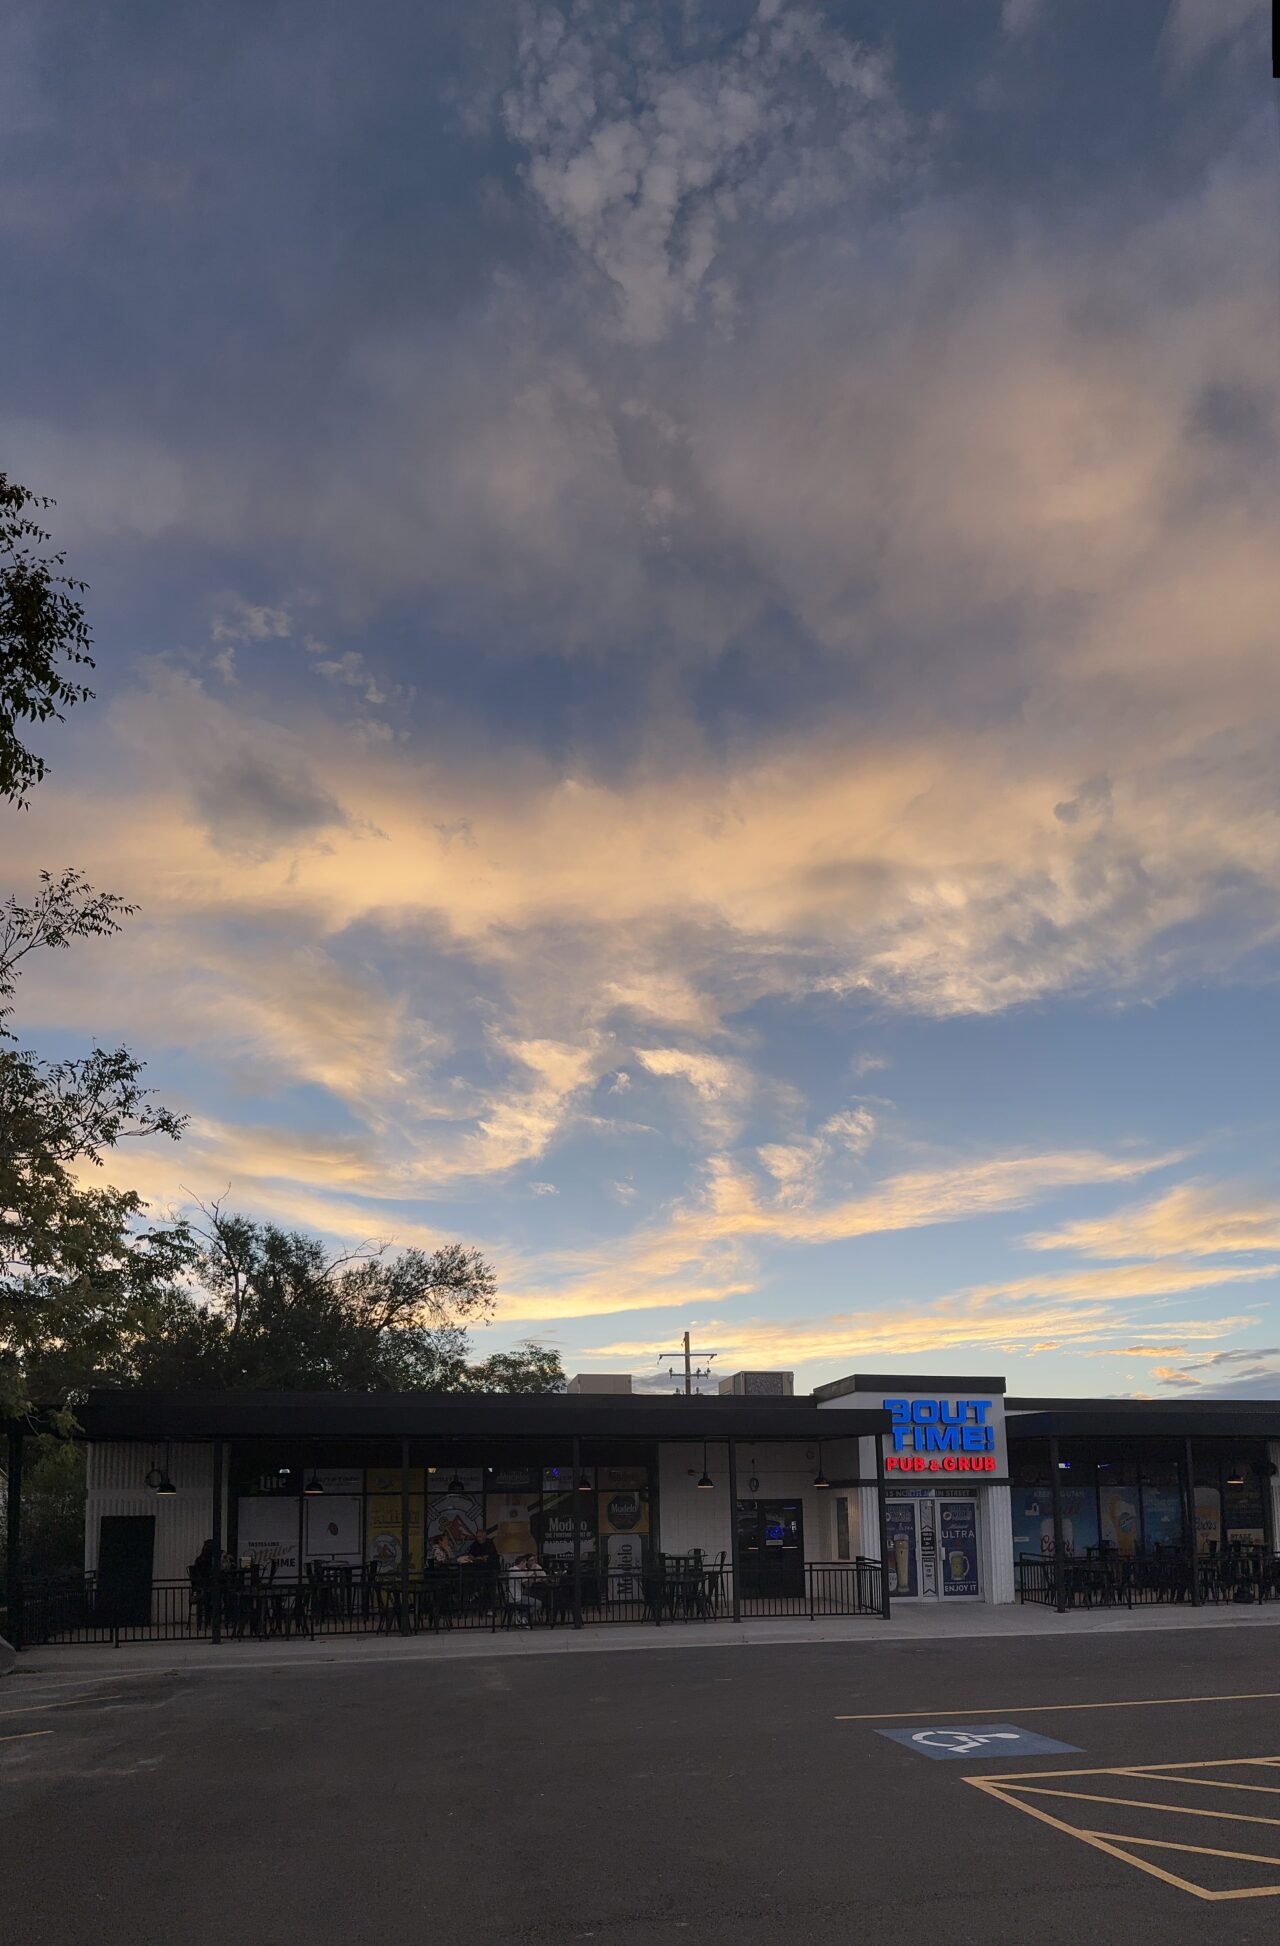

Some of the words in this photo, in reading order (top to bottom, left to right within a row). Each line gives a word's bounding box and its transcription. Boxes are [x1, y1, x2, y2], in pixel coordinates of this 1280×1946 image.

[883, 1400, 992, 1424] BOUT
[891, 1426, 994, 1452] TIME!
[886, 1456, 925, 1471] PUB
[929, 1459, 940, 1471] &
[943, 1456, 996, 1471] GRUB
[611, 1504, 637, 1513] Modelo
[942, 1530, 975, 1539] ULTRA
